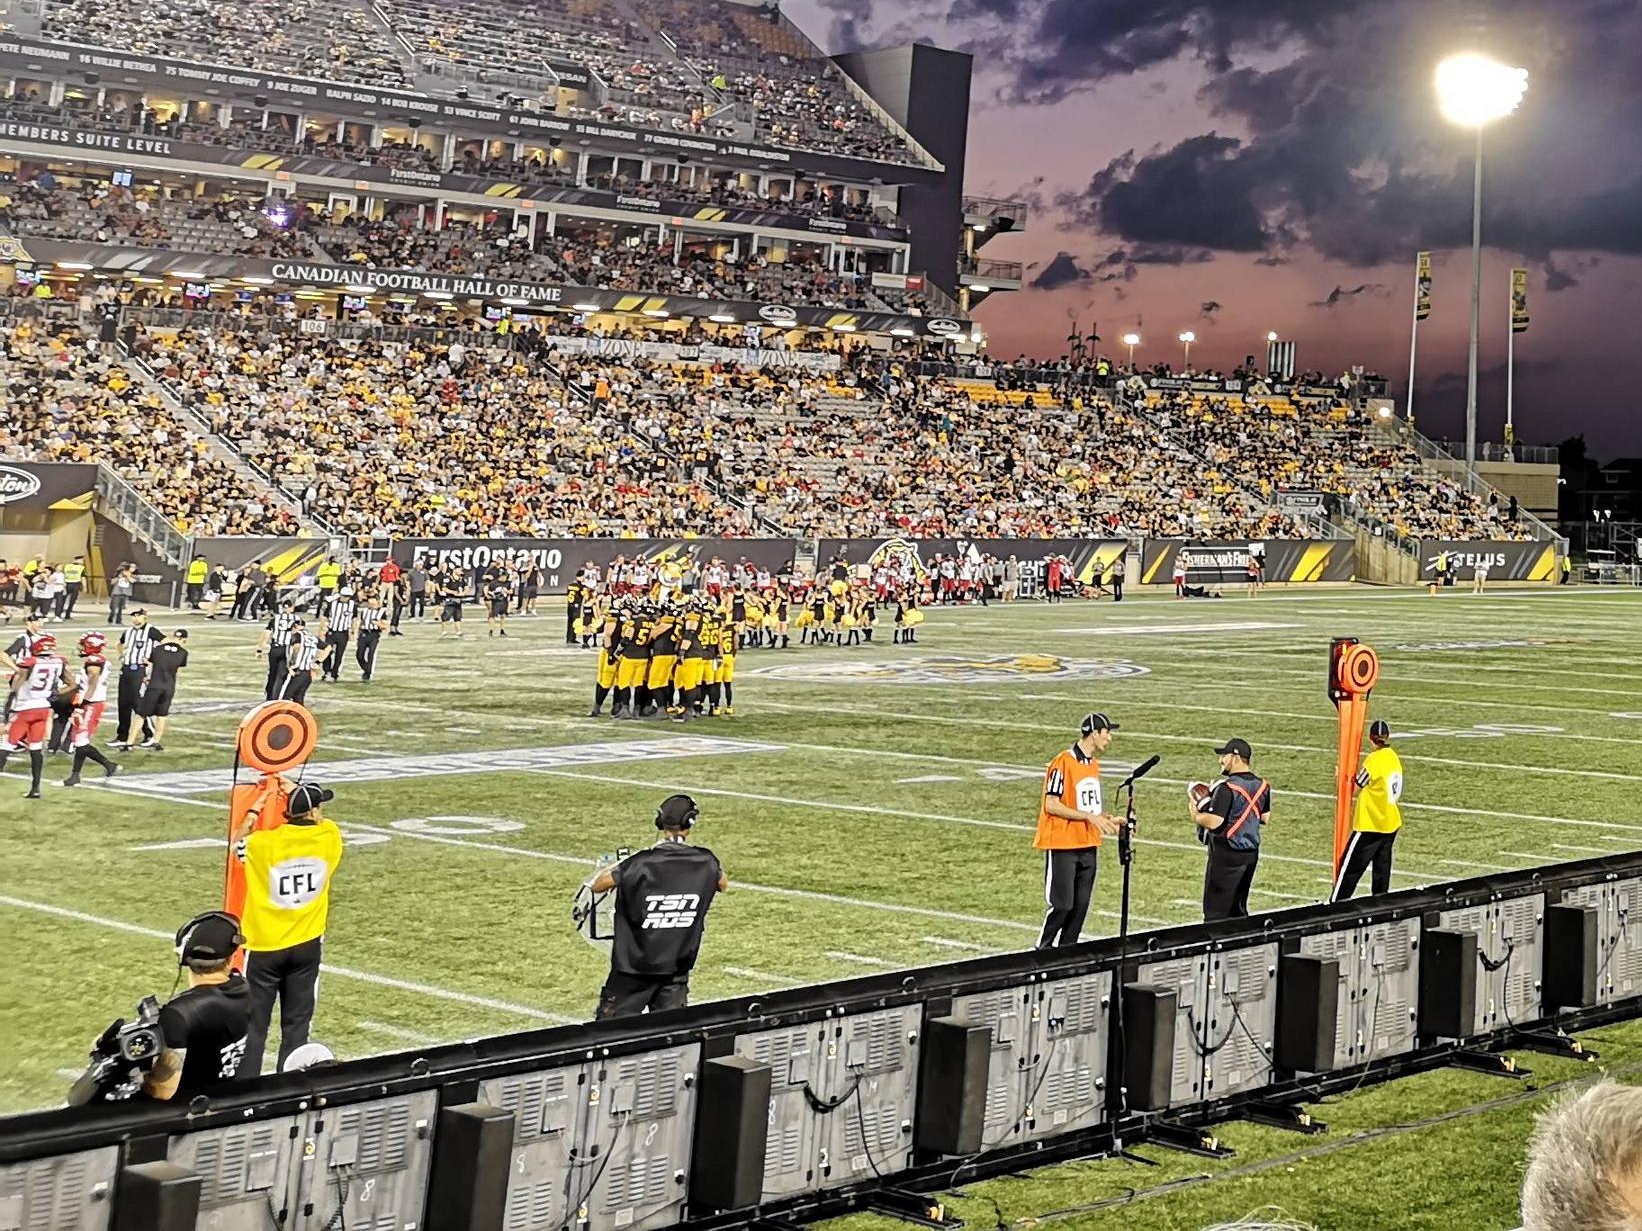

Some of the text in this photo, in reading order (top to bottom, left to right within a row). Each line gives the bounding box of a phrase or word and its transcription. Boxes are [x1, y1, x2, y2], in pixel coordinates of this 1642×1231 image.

[211, 72, 228, 83] JOE
[76, 132, 120, 148] SUITE
[127, 138, 171, 154] LEVEL
[272, 263, 562, 302] CANADIAN FOOTBALL HALL OF FAME
[303, 321, 322, 332] 106
[1081, 789, 1100, 806] CFL
[279, 872, 316, 896] CFL
[645, 894, 700, 911] TSN
[641, 911, 697, 929] RDS
[360, 1179, 375, 1201] 8
